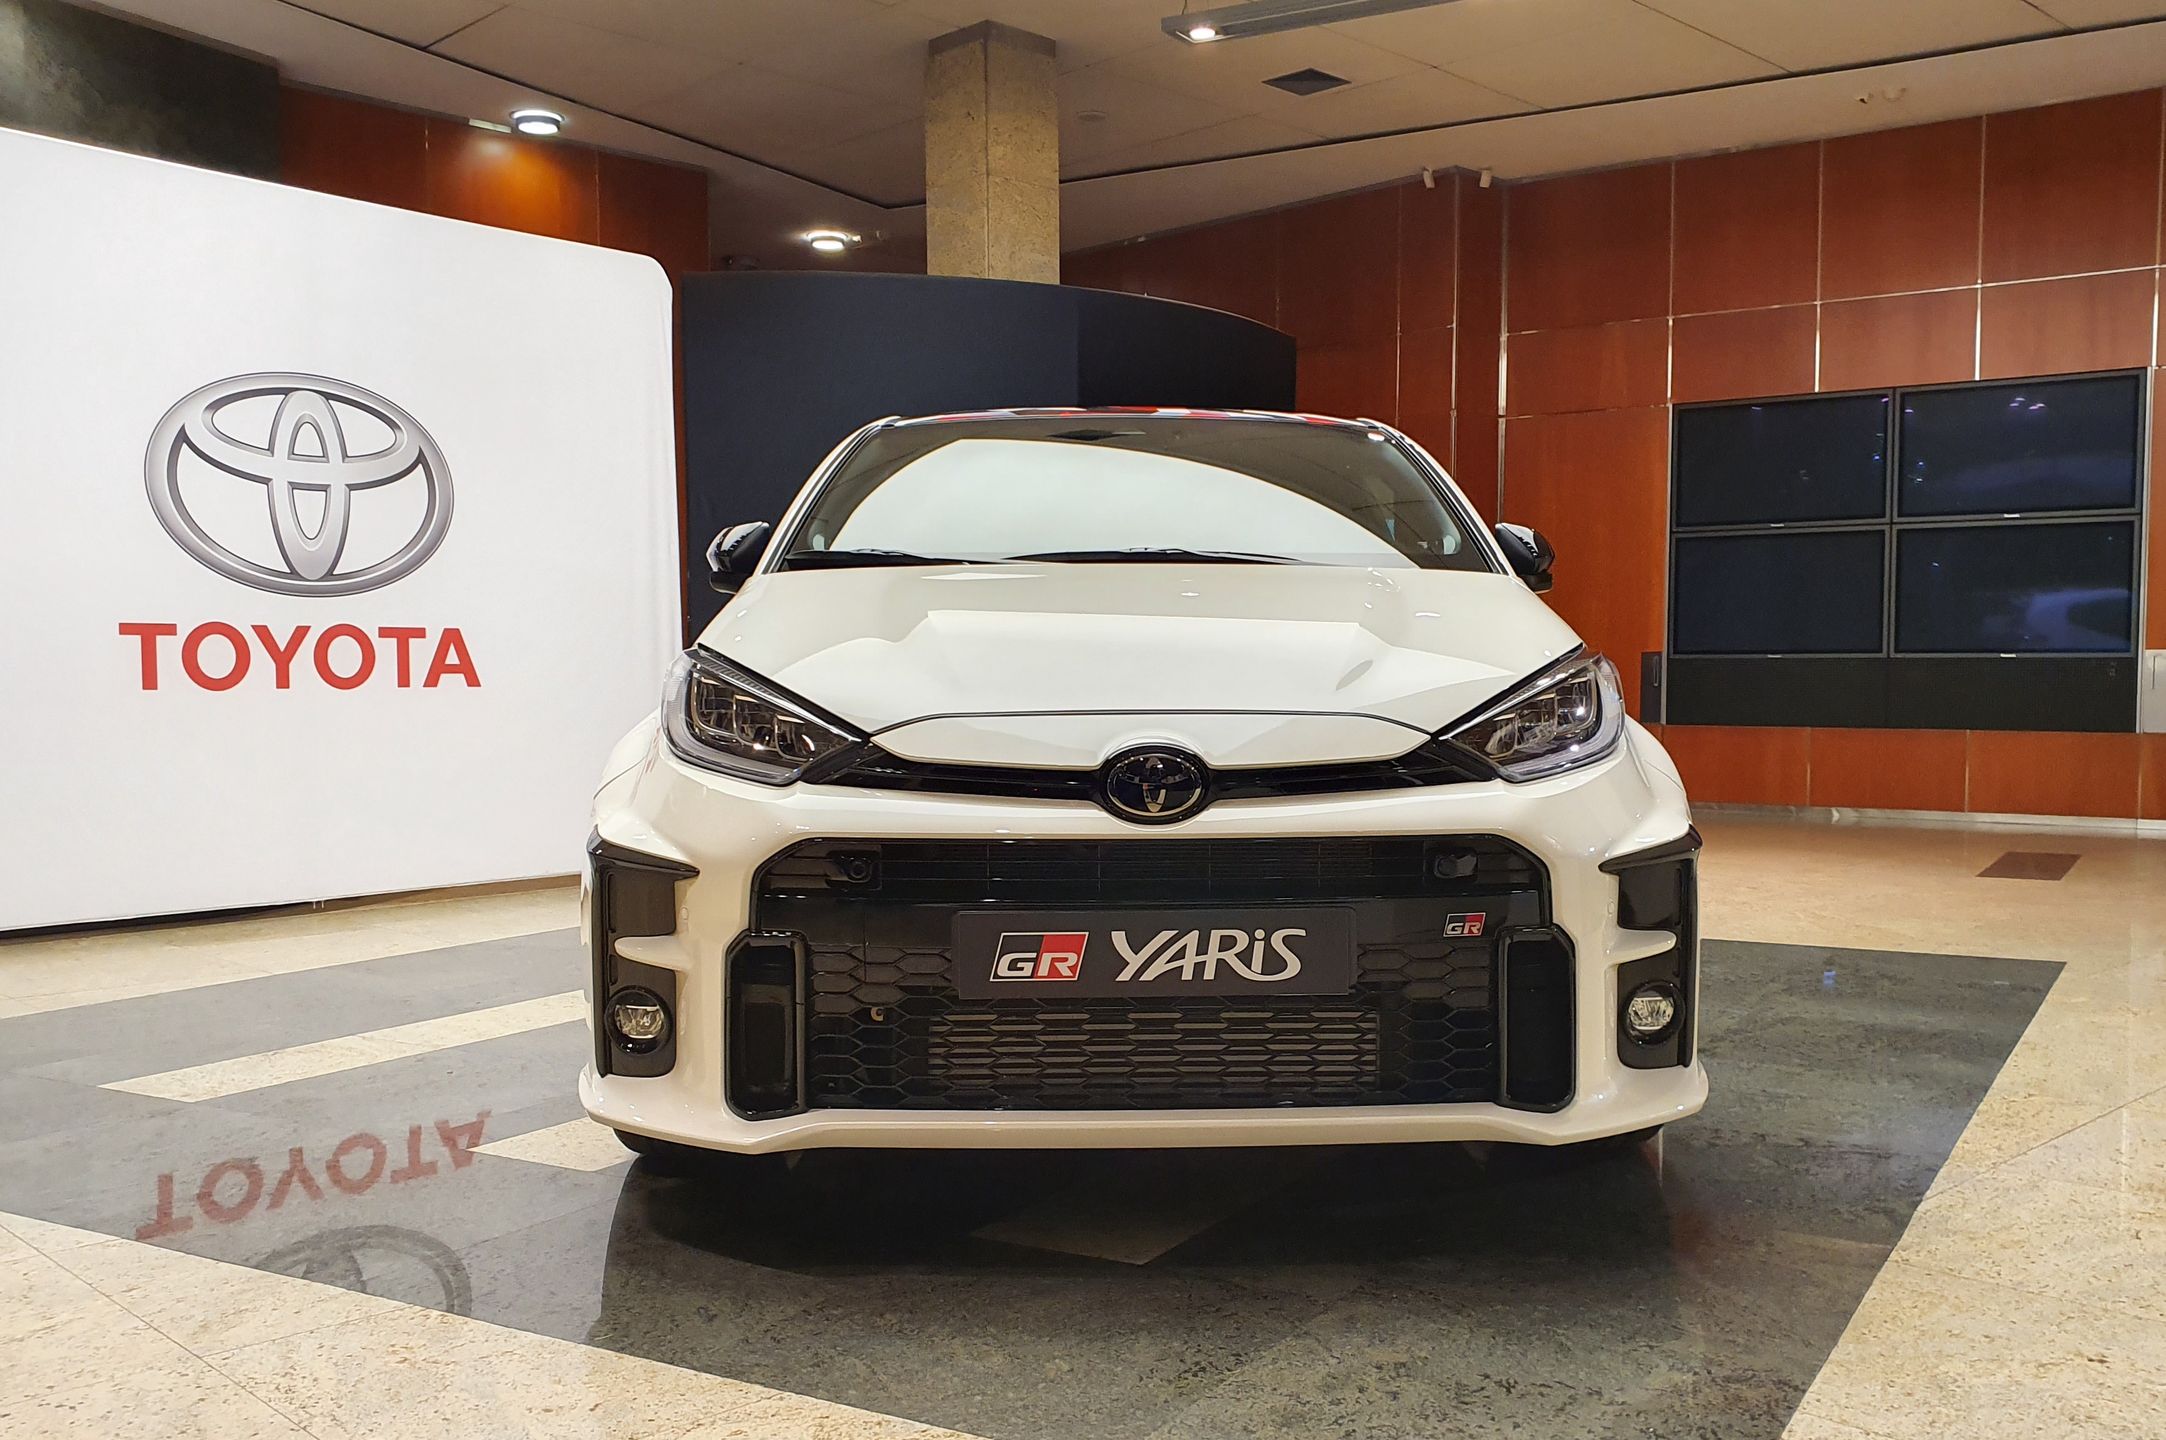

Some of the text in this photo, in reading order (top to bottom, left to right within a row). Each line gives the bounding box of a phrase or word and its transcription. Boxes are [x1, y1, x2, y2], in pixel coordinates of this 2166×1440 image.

[118, 621, 481, 692] TOYOTA
[1446, 922, 1481, 935] GR
[996, 952, 1079, 977] GR
